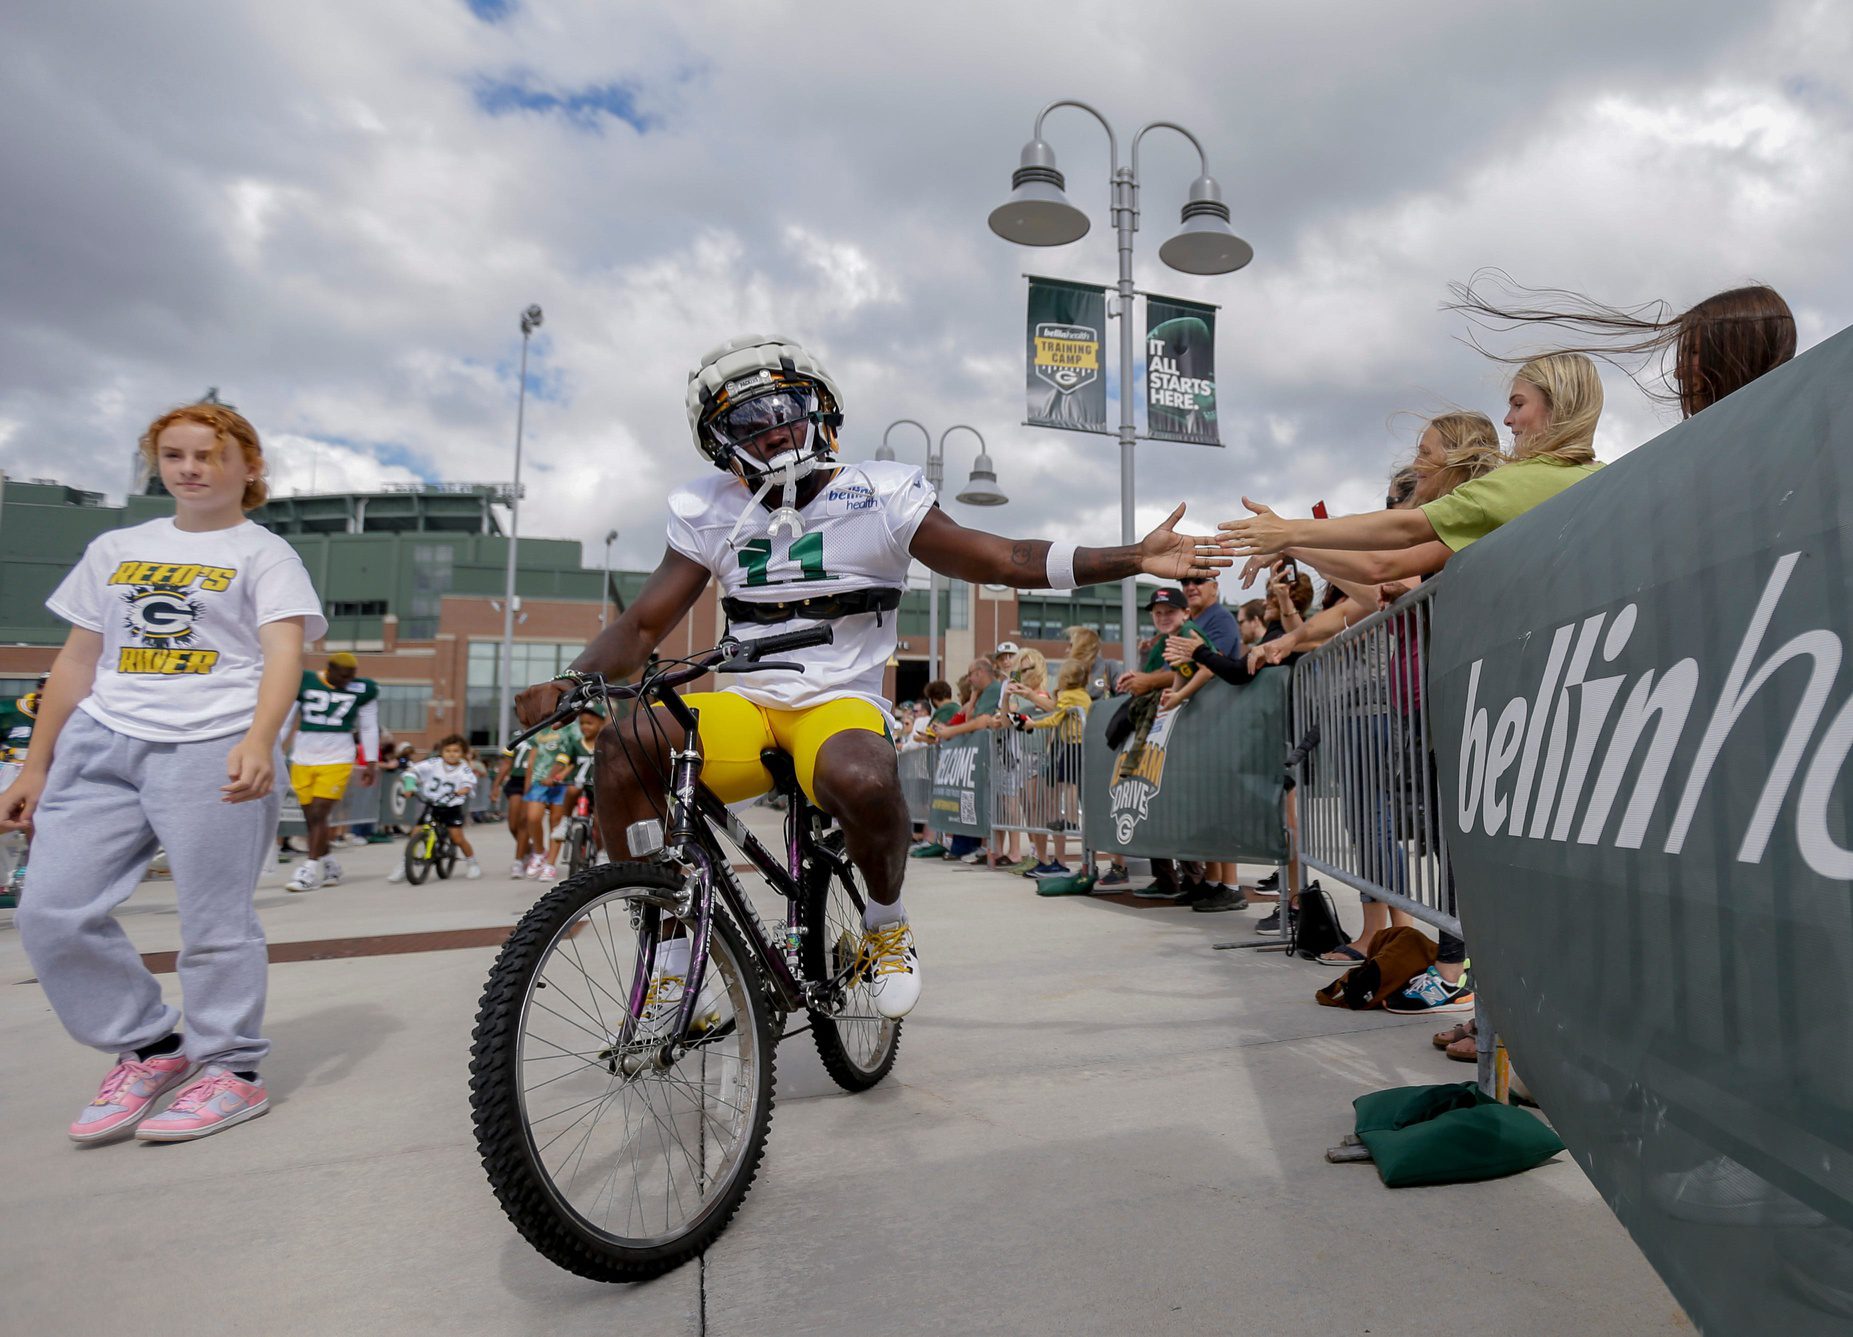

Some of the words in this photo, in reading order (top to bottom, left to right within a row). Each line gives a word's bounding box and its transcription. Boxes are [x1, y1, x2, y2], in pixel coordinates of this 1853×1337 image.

[1041, 341, 1092, 355] TRAINING
[1052, 352, 1082, 365] CAMP
[1149, 339, 1166, 356] IT
[1149, 355, 1180, 376] ALL
[1055, 370, 1078, 385] G
[1150, 371, 1212, 396] STARTS
[1150, 388, 1199, 410] HERE.
[846, 497, 878, 510] health
[108, 561, 237, 592] REED'S
[118, 646, 219, 674] RIDER
[301, 689, 357, 727] 27
[1112, 780, 1149, 815] DRIVE
[1118, 819, 1132, 841] G
